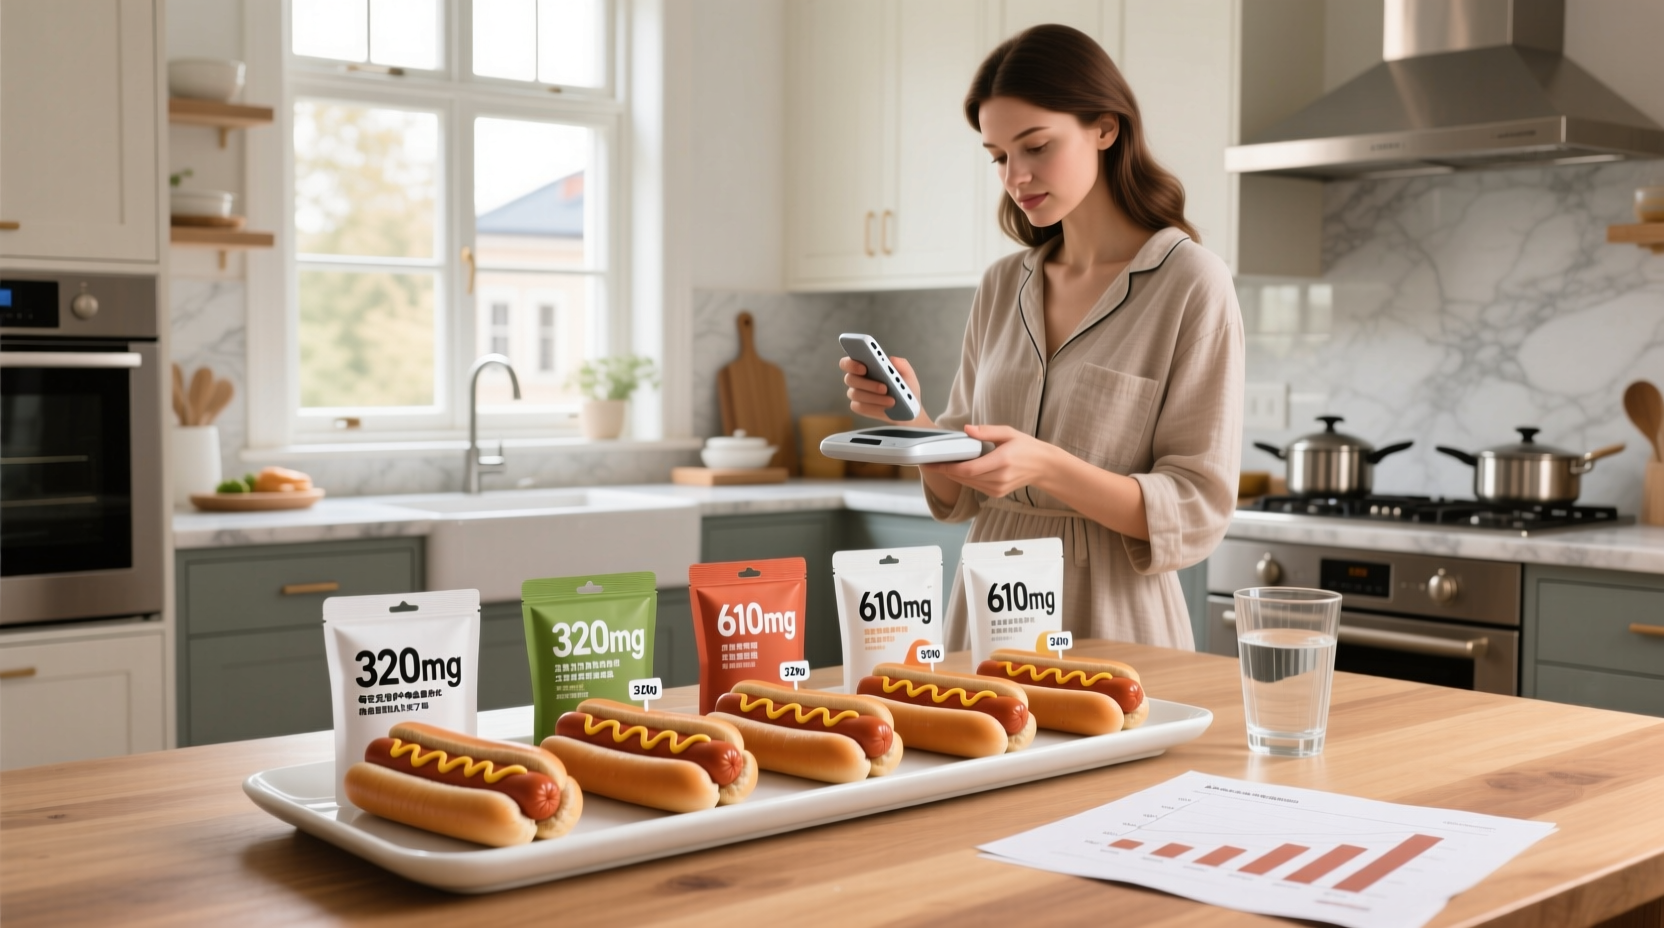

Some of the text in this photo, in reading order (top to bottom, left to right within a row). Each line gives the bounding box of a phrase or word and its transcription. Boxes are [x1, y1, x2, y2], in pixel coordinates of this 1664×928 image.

[859, 590, 932, 624] 610mg
[987, 581, 1055, 615] 610mg
[552, 620, 645, 659] 320mg
[717, 602, 796, 640] 610mg
[355, 647, 462, 687] 320mg
